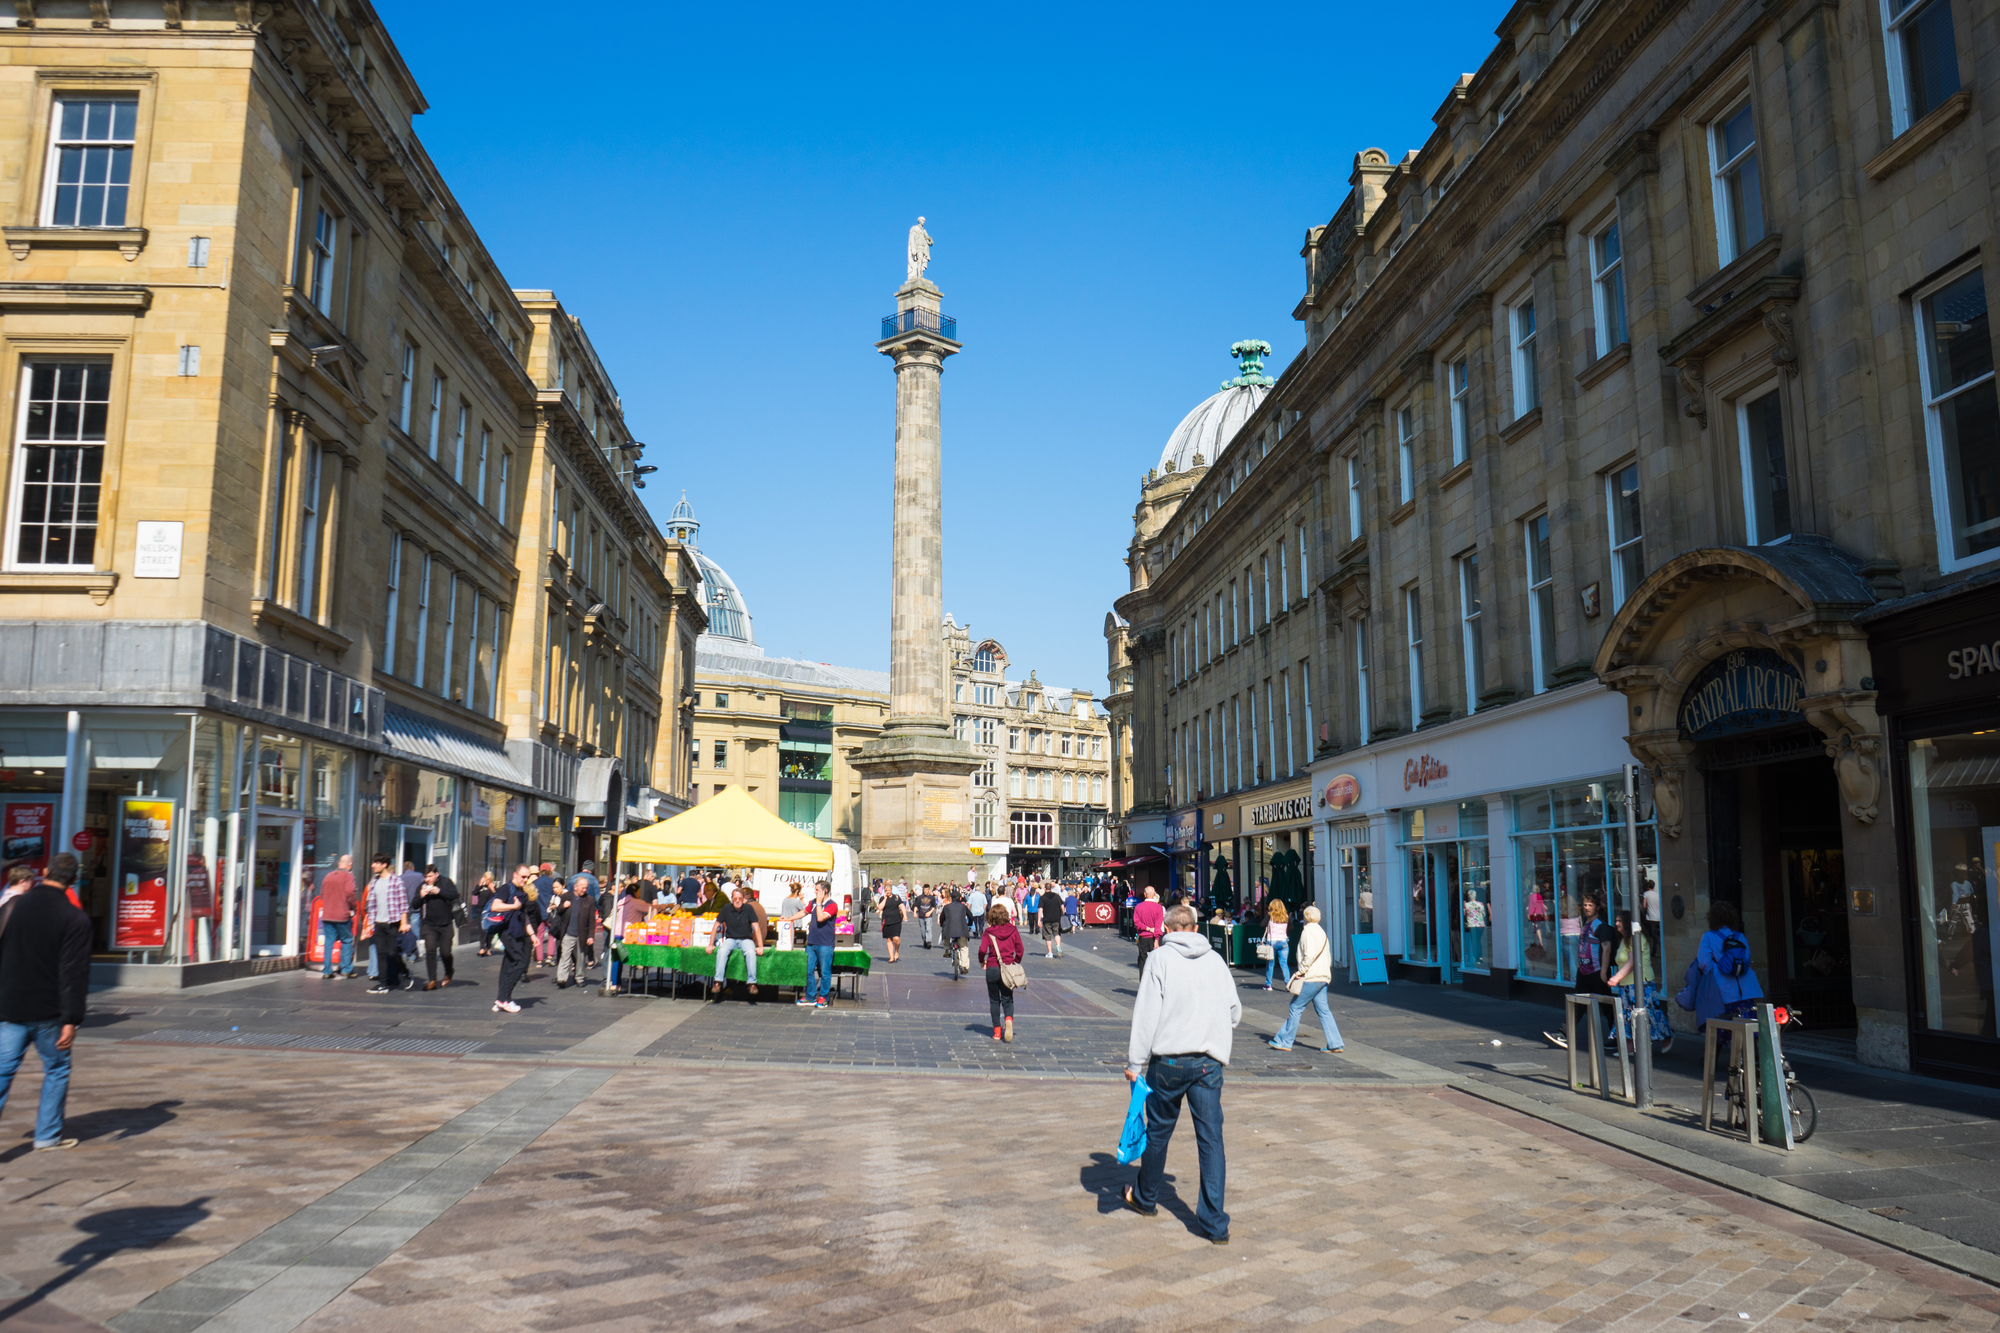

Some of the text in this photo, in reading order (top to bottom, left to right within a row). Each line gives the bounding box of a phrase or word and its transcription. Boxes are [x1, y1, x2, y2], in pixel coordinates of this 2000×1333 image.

[140, 544, 178, 552] NELSON
[141, 556, 174, 564] STREET
[1726, 651, 1746, 671] 1906
[1684, 665, 1803, 734] CENTRAL ARCADE
[1251, 800, 1293, 825] STARBUCKS
[788, 821, 821, 831] REISS
